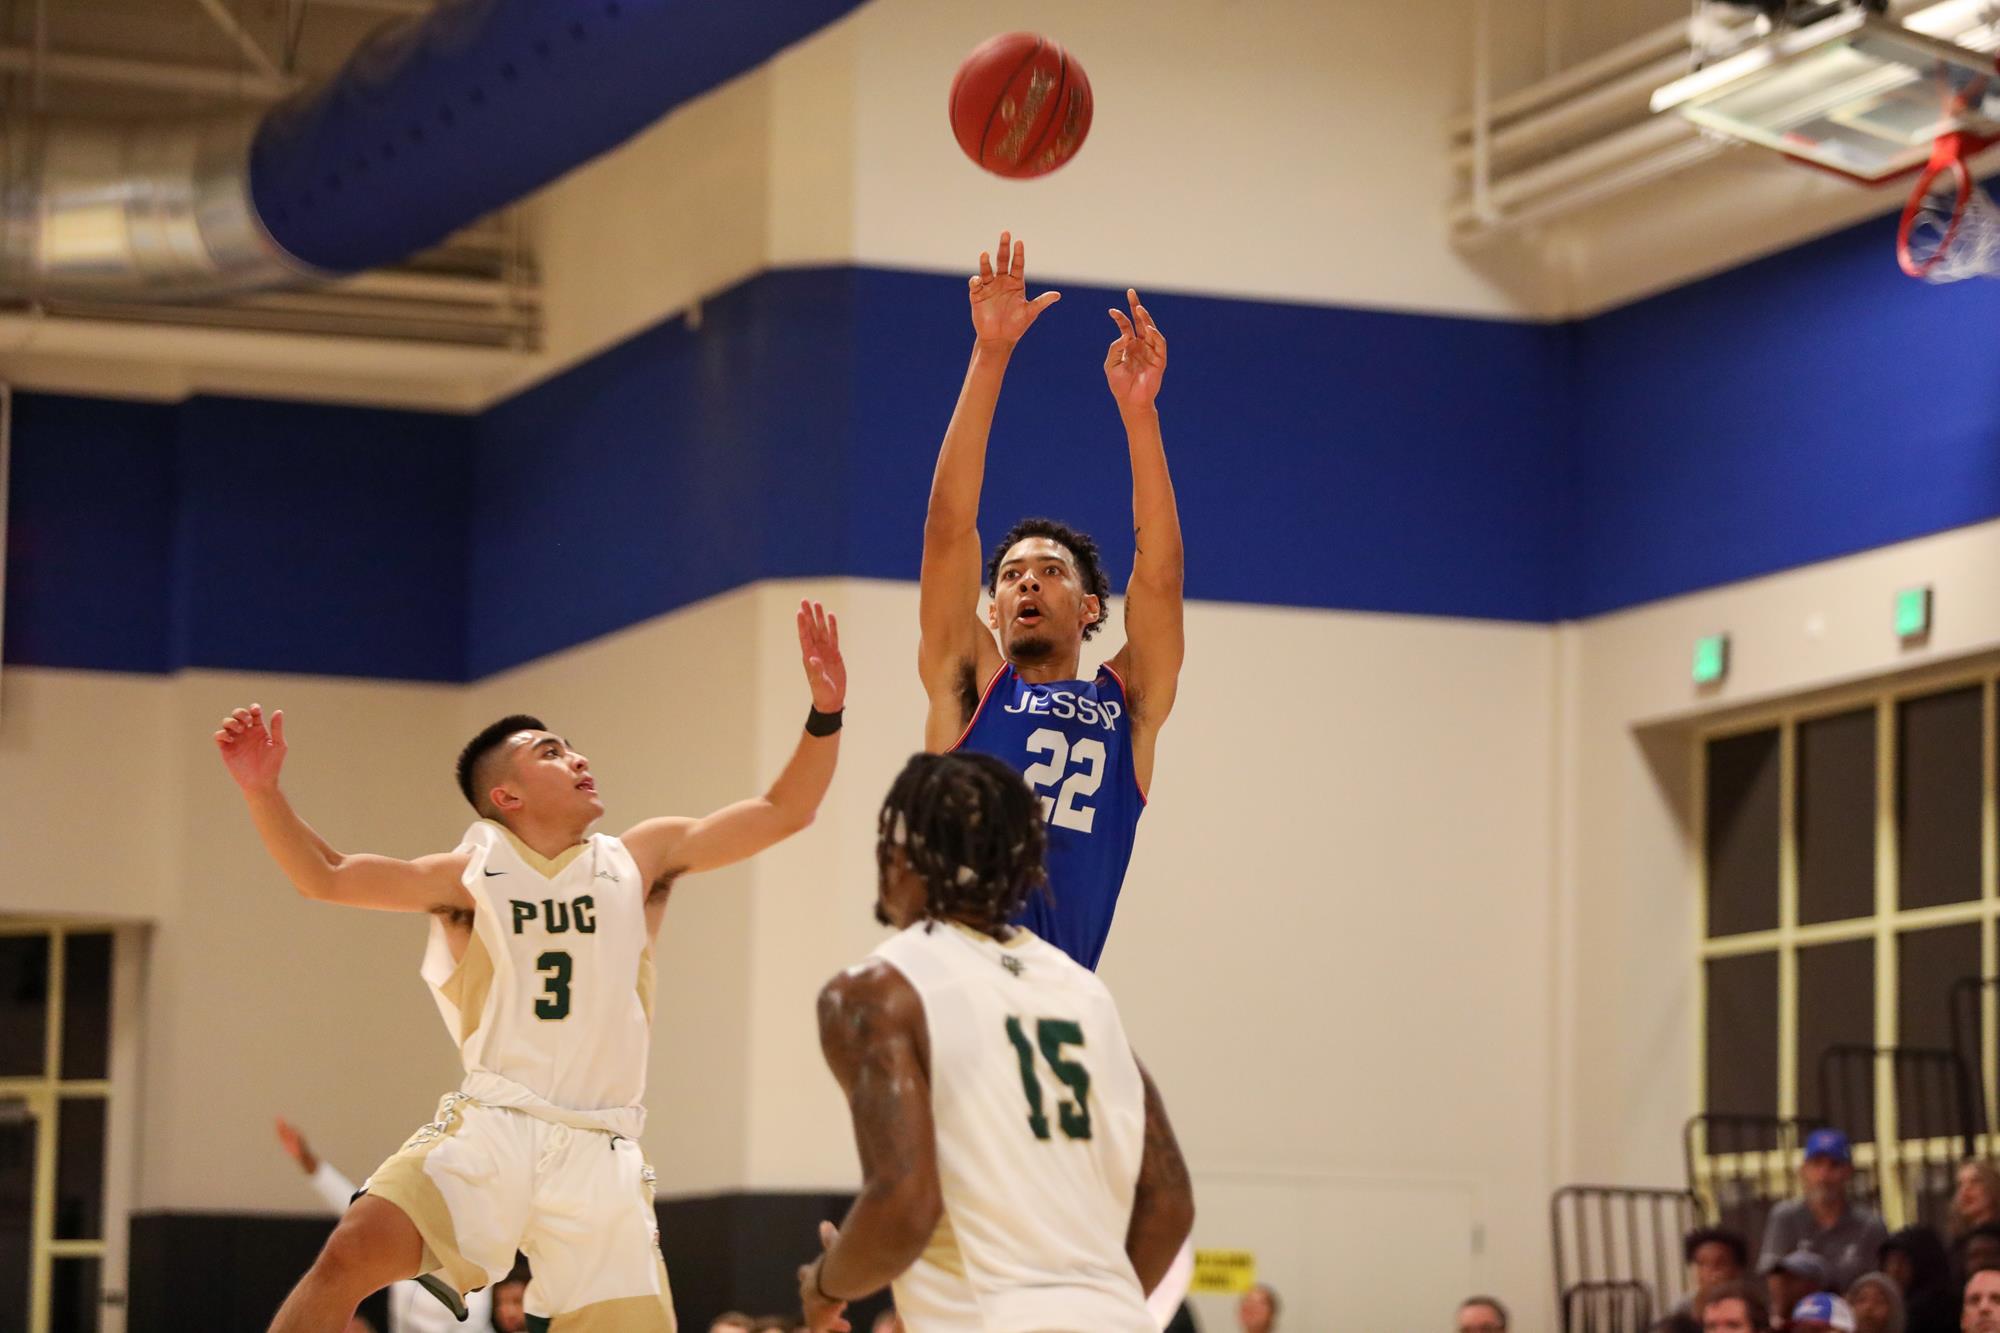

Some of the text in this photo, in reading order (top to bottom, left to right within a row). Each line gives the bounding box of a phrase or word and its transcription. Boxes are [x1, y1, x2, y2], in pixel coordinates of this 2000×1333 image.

[1023, 727, 1107, 834] 22
[509, 895, 597, 934] PUC
[534, 951, 573, 1020] 3
[1005, 1016, 1093, 1140] 15
